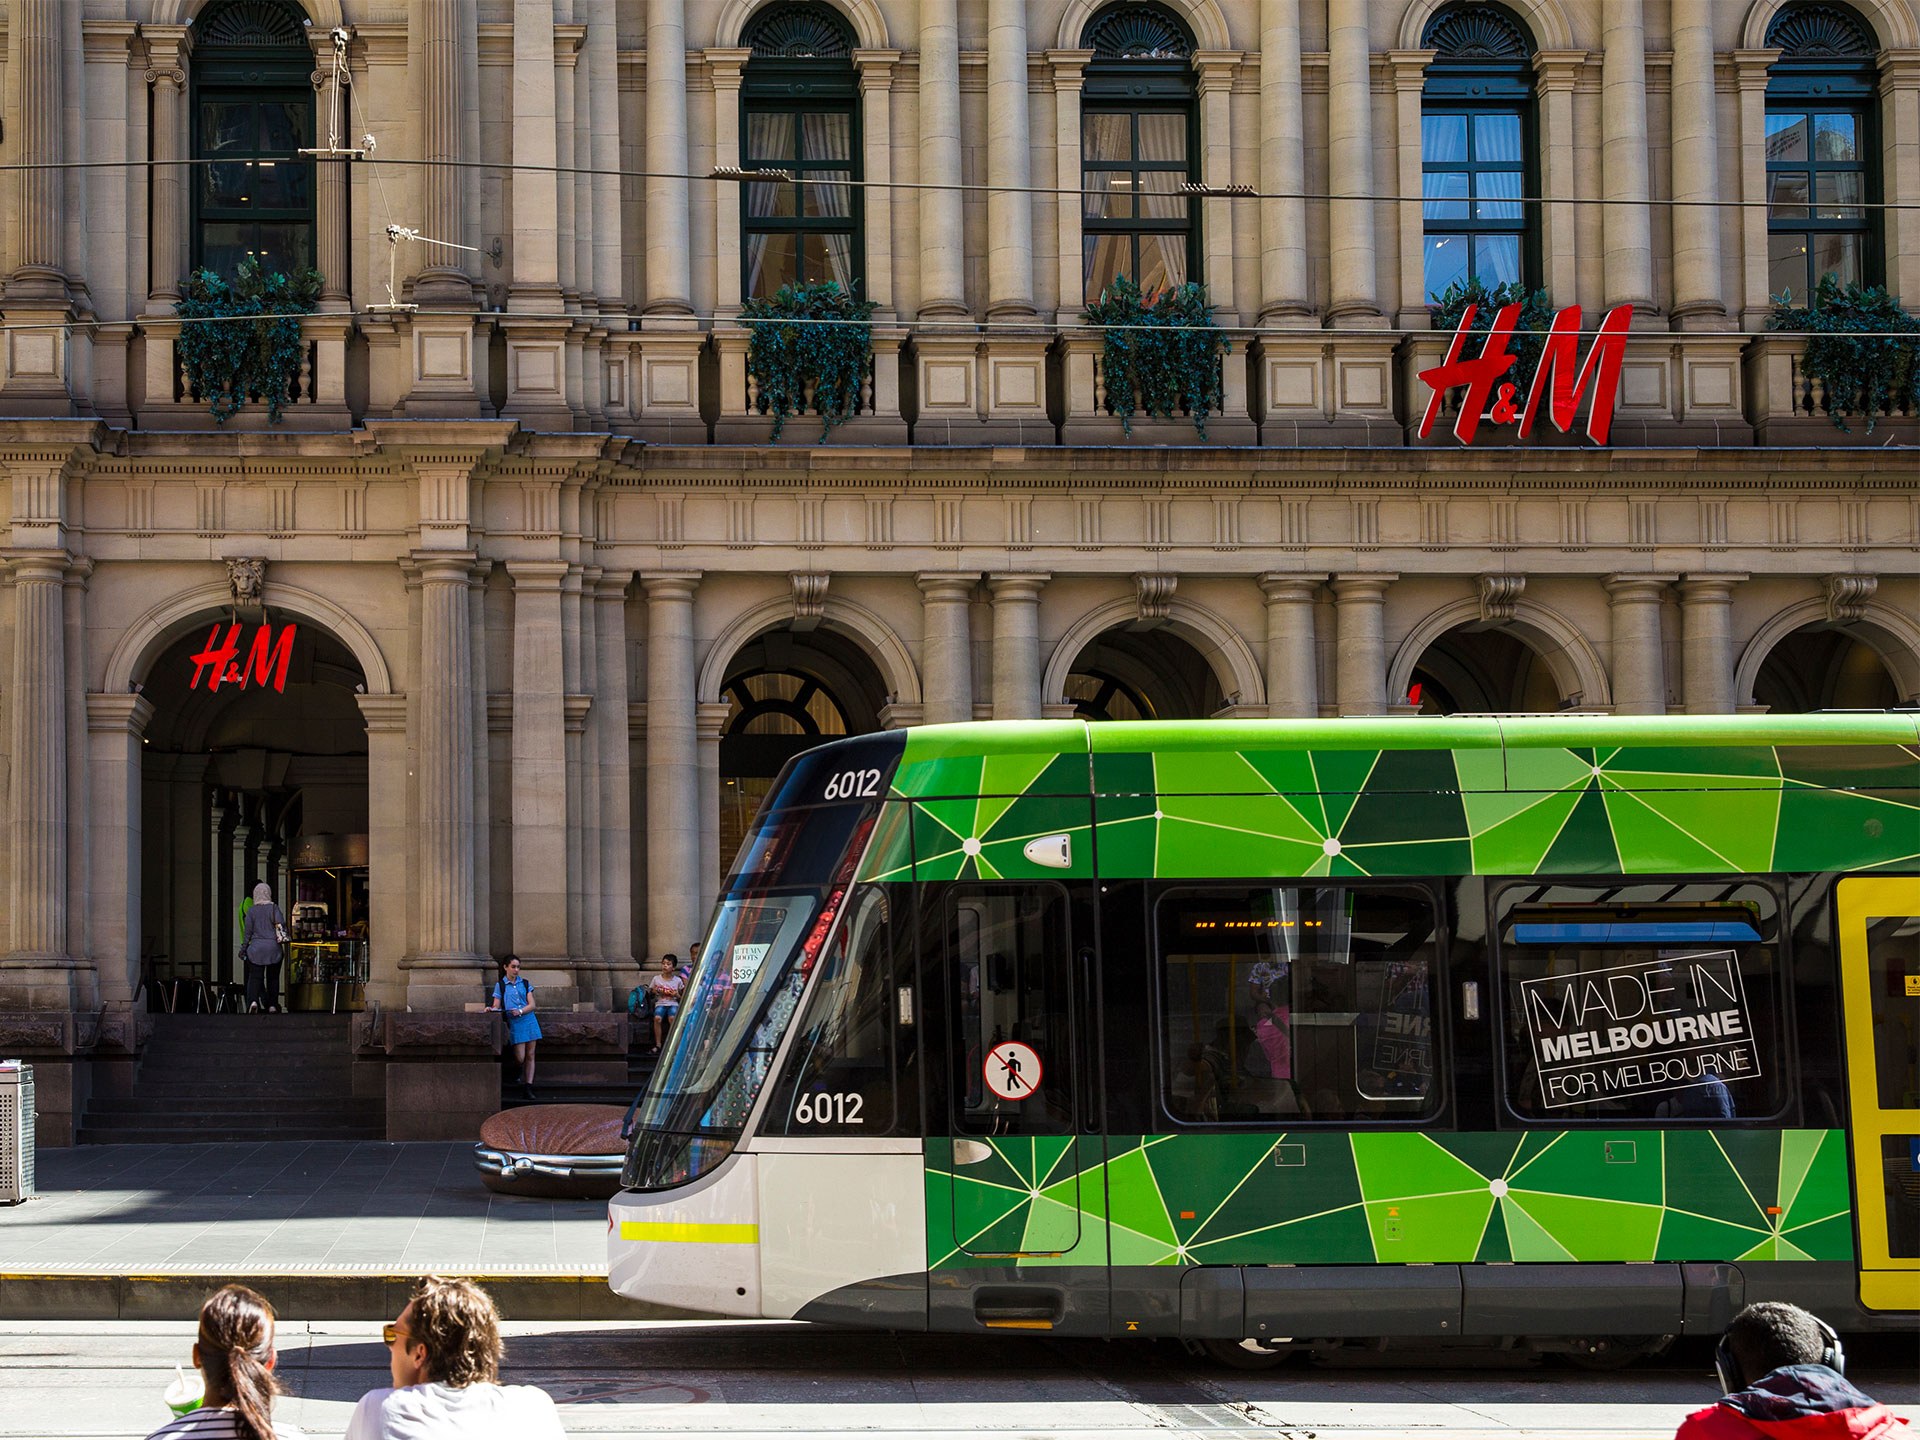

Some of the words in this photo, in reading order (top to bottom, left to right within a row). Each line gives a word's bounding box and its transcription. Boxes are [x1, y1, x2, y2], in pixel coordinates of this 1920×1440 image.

[1416, 302, 1634, 446] H&M
[189, 623, 297, 694] H&M
[824, 768, 881, 800] 6012
[1530, 968, 1681, 1033] MADE
[1688, 959, 1738, 1008] IN
[1540, 1009, 1744, 1063] MELBOURNE
[1548, 1071, 1599, 1099] FOR
[1602, 1048, 1752, 1091] MELBOURNE
[795, 1092, 864, 1124] 6012
